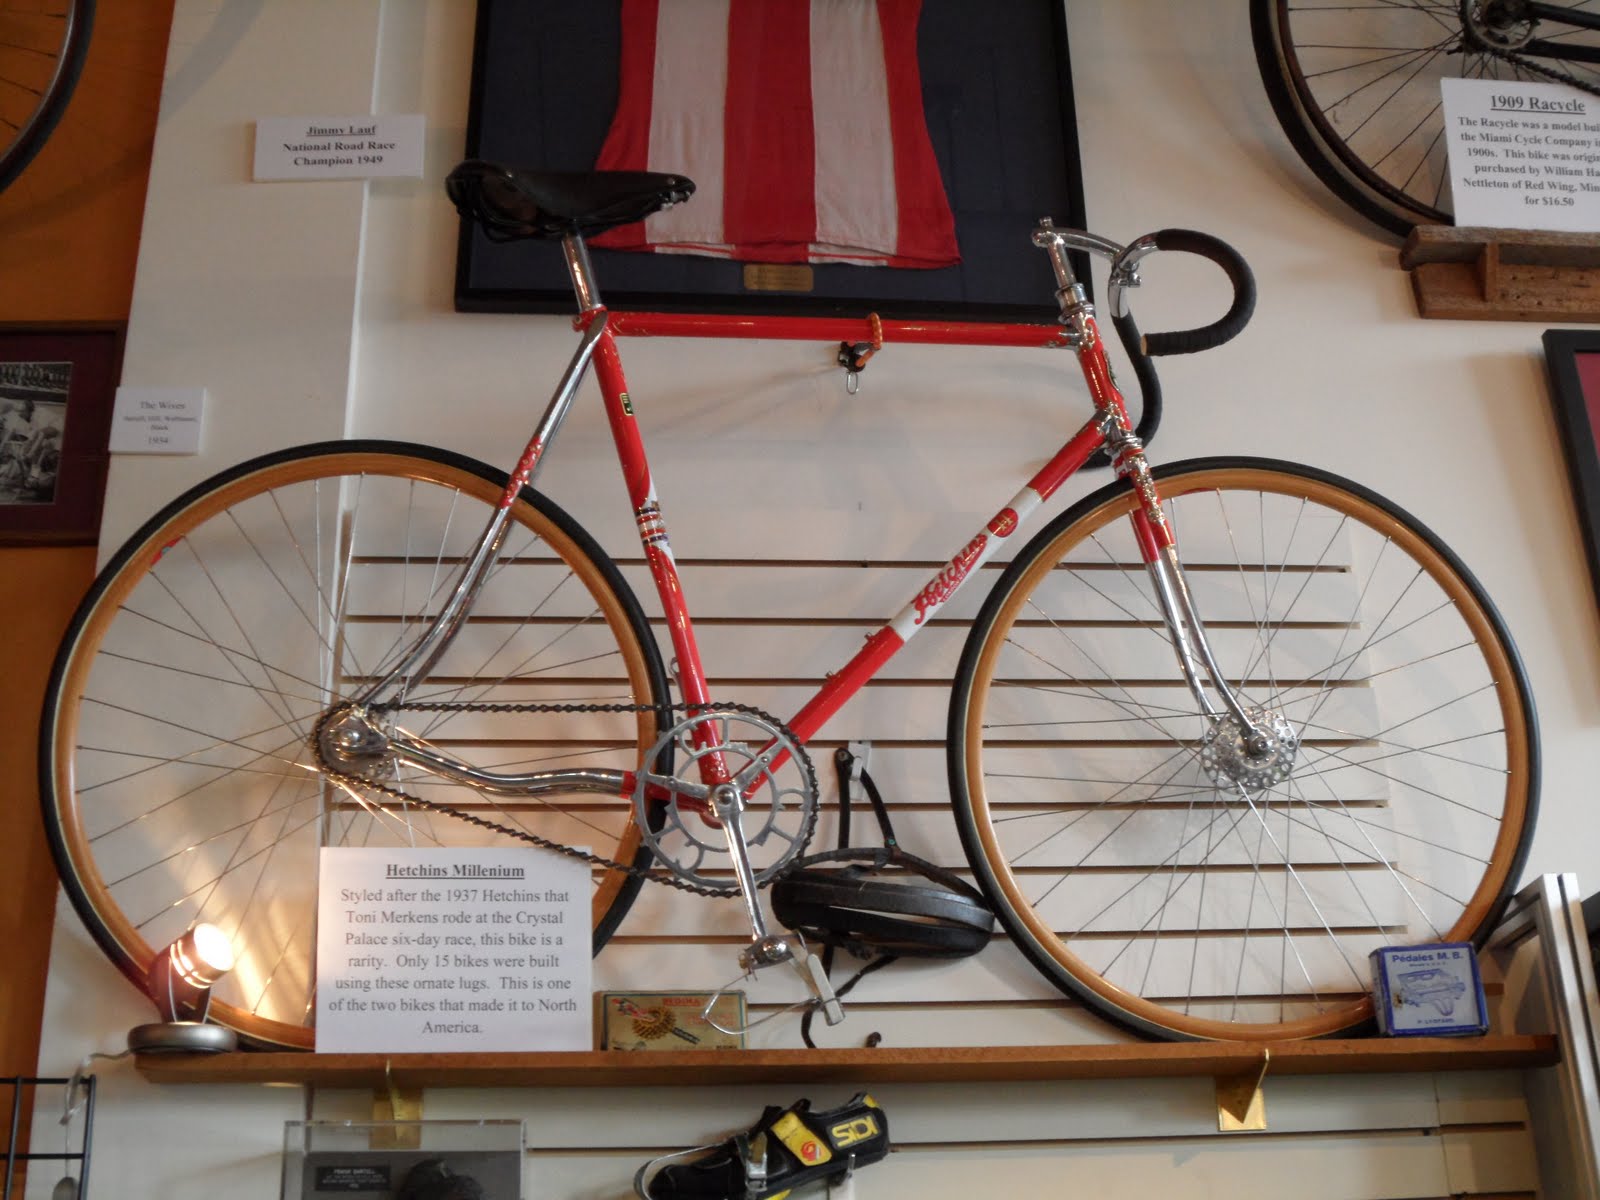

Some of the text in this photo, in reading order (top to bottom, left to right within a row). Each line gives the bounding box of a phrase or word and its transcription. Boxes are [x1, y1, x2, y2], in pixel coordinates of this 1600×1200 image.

[1491, 95, 1585, 112] 1909 Racycle
[307, 126, 344, 134] Jimmy
[1458, 117, 1477, 126] The
[1480, 118, 1518, 130] Racycle
[1552, 121, 1581, 130] model
[284, 141, 395, 151] National Road Race
[1461, 133, 1476, 141] the
[1480, 133, 1512, 143] Miami
[1515, 136, 1542, 147] Cycle
[1545, 136, 1591, 148] Company
[1468, 148, 1498, 157] 1900s.
[1503, 149, 1525, 158] This
[1529, 150, 1549, 159] bike
[294, 156, 383, 167] Champion 1949
[1475, 163, 1525, 174] purchased
[1529, 165, 1540, 176] by
[1544, 166, 1583, 176] William
[1463, 178, 1509, 188] Nettleton
[1512, 180, 1521, 188] of
[1525, 180, 1544, 189] Red
[1547, 181, 1577, 192] Wing,
[1525, 196, 1574, 206] for $16.50
[386, 864, 524, 877] Hetchins Millenium
[341, 889, 568, 904] Styled after the 1937 Hetchins that
[346, 911, 563, 926] Toni Merkens rode at the Crystal
[345, 933, 563, 948] Palace six-day race, this bike is a
[348, 954, 559, 970] rarity. Only 15 bikes were built
[335, 976, 571, 992] using these ornate lugs. This is one
[329, 998, 577, 1011] of the two bikes that made it to North
[422, 1021, 483, 1034] America.
[831, 1115, 879, 1148] SIDI
